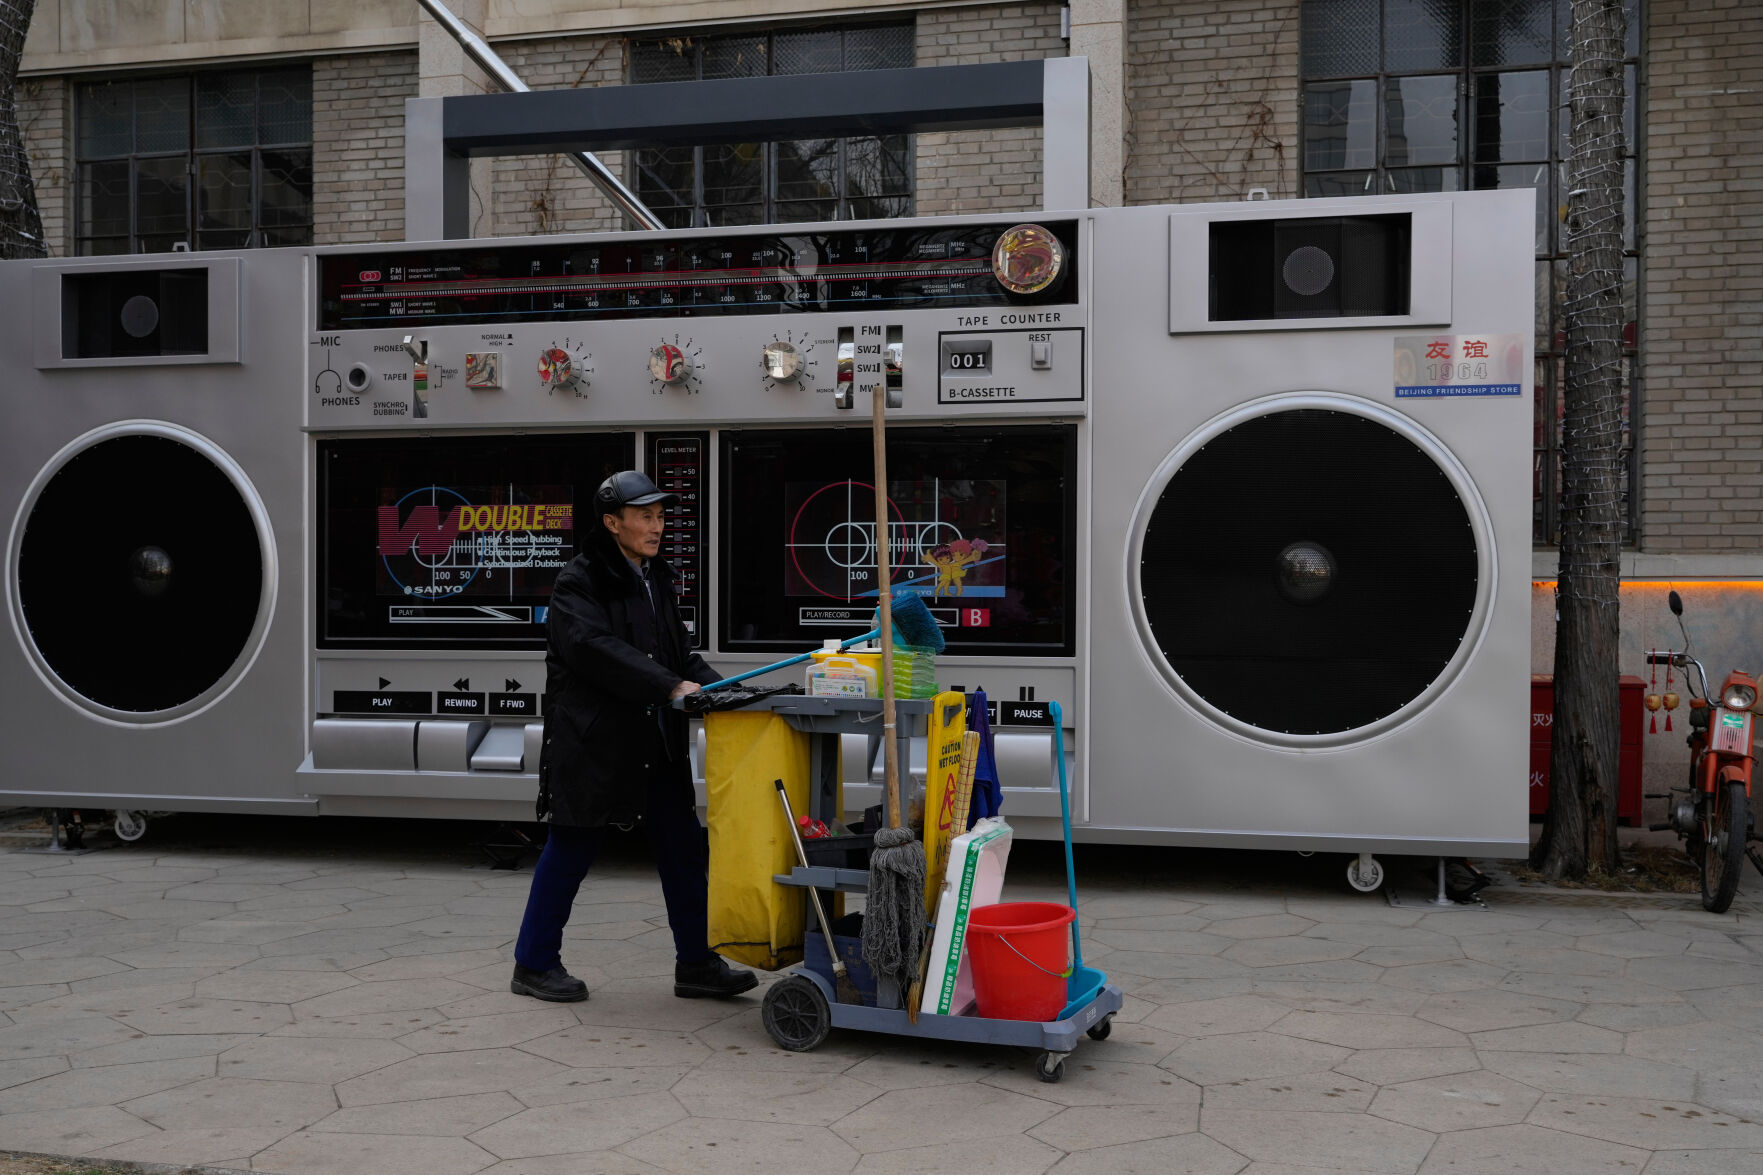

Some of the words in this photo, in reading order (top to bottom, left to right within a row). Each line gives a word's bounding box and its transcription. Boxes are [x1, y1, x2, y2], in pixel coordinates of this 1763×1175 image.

[390, 267, 403, 275] FM
[951, 282, 966, 290] MHz
[756, 294, 772, 302] 1200
[850, 290, 866, 298] 1600
[553, 301, 565, 309] 540
[389, 308, 404, 316] MW
[957, 315, 989, 328] TAPE
[1000, 312, 1062, 326] COUNTER
[861, 326, 878, 336] FM
[320, 335, 341, 347] MIC
[1028, 333, 1053, 343] REST
[373, 344, 405, 352] PHONES
[857, 345, 877, 355] SW2
[1425, 340, 1489, 360] 友谊
[951, 353, 986, 369] 001
[857, 364, 878, 374] SW1
[1426, 362, 1489, 381] 1964
[383, 373, 402, 381] TAPE
[859, 384, 876, 393] MW
[949, 387, 1017, 399] B-CASSETTE
[1398, 388, 1433, 397] BEIJING
[1436, 386, 1487, 396] FRIENDSHIP
[1490, 385, 1519, 395] STORE
[321, 397, 360, 407] PHONES
[373, 401, 405, 409] SYNCHRO
[373, 408, 405, 416] DUBBING
[661, 447, 678, 455] LEVEL
[678, 447, 697, 455] METER
[687, 467, 697, 476] 50
[687, 493, 697, 501] 40
[545, 505, 573, 517] CASSETTE
[458, 505, 546, 531] DOUBLE
[545, 518, 562, 529] DECK
[687, 519, 697, 528] 30
[505, 535, 529, 546] Speed
[530, 535, 562, 545] Dubbing
[527, 547, 561, 558] Playback
[687, 544, 697, 553] 20
[534, 558, 567, 569] Dubbing
[434, 571, 451, 580] 100
[459, 571, 471, 580] 50
[485, 570, 492, 579] 0
[687, 572, 697, 581] 10
[850, 570, 869, 580] 100
[907, 569, 915, 579] 0
[414, 584, 463, 594] SANYO
[398, 608, 414, 616] PLAY
[805, 611, 851, 620] PLAY/RECORD
[970, 609, 983, 627] B
[372, 698, 393, 707] PLAY
[444, 698, 478, 708] REWIND
[506, 700, 526, 708] FWD
[1014, 709, 1044, 719] PAUSE
[941, 742, 961, 755] CAUTION
[939, 757, 949, 769] WET
[949, 754, 961, 767] FLOO
